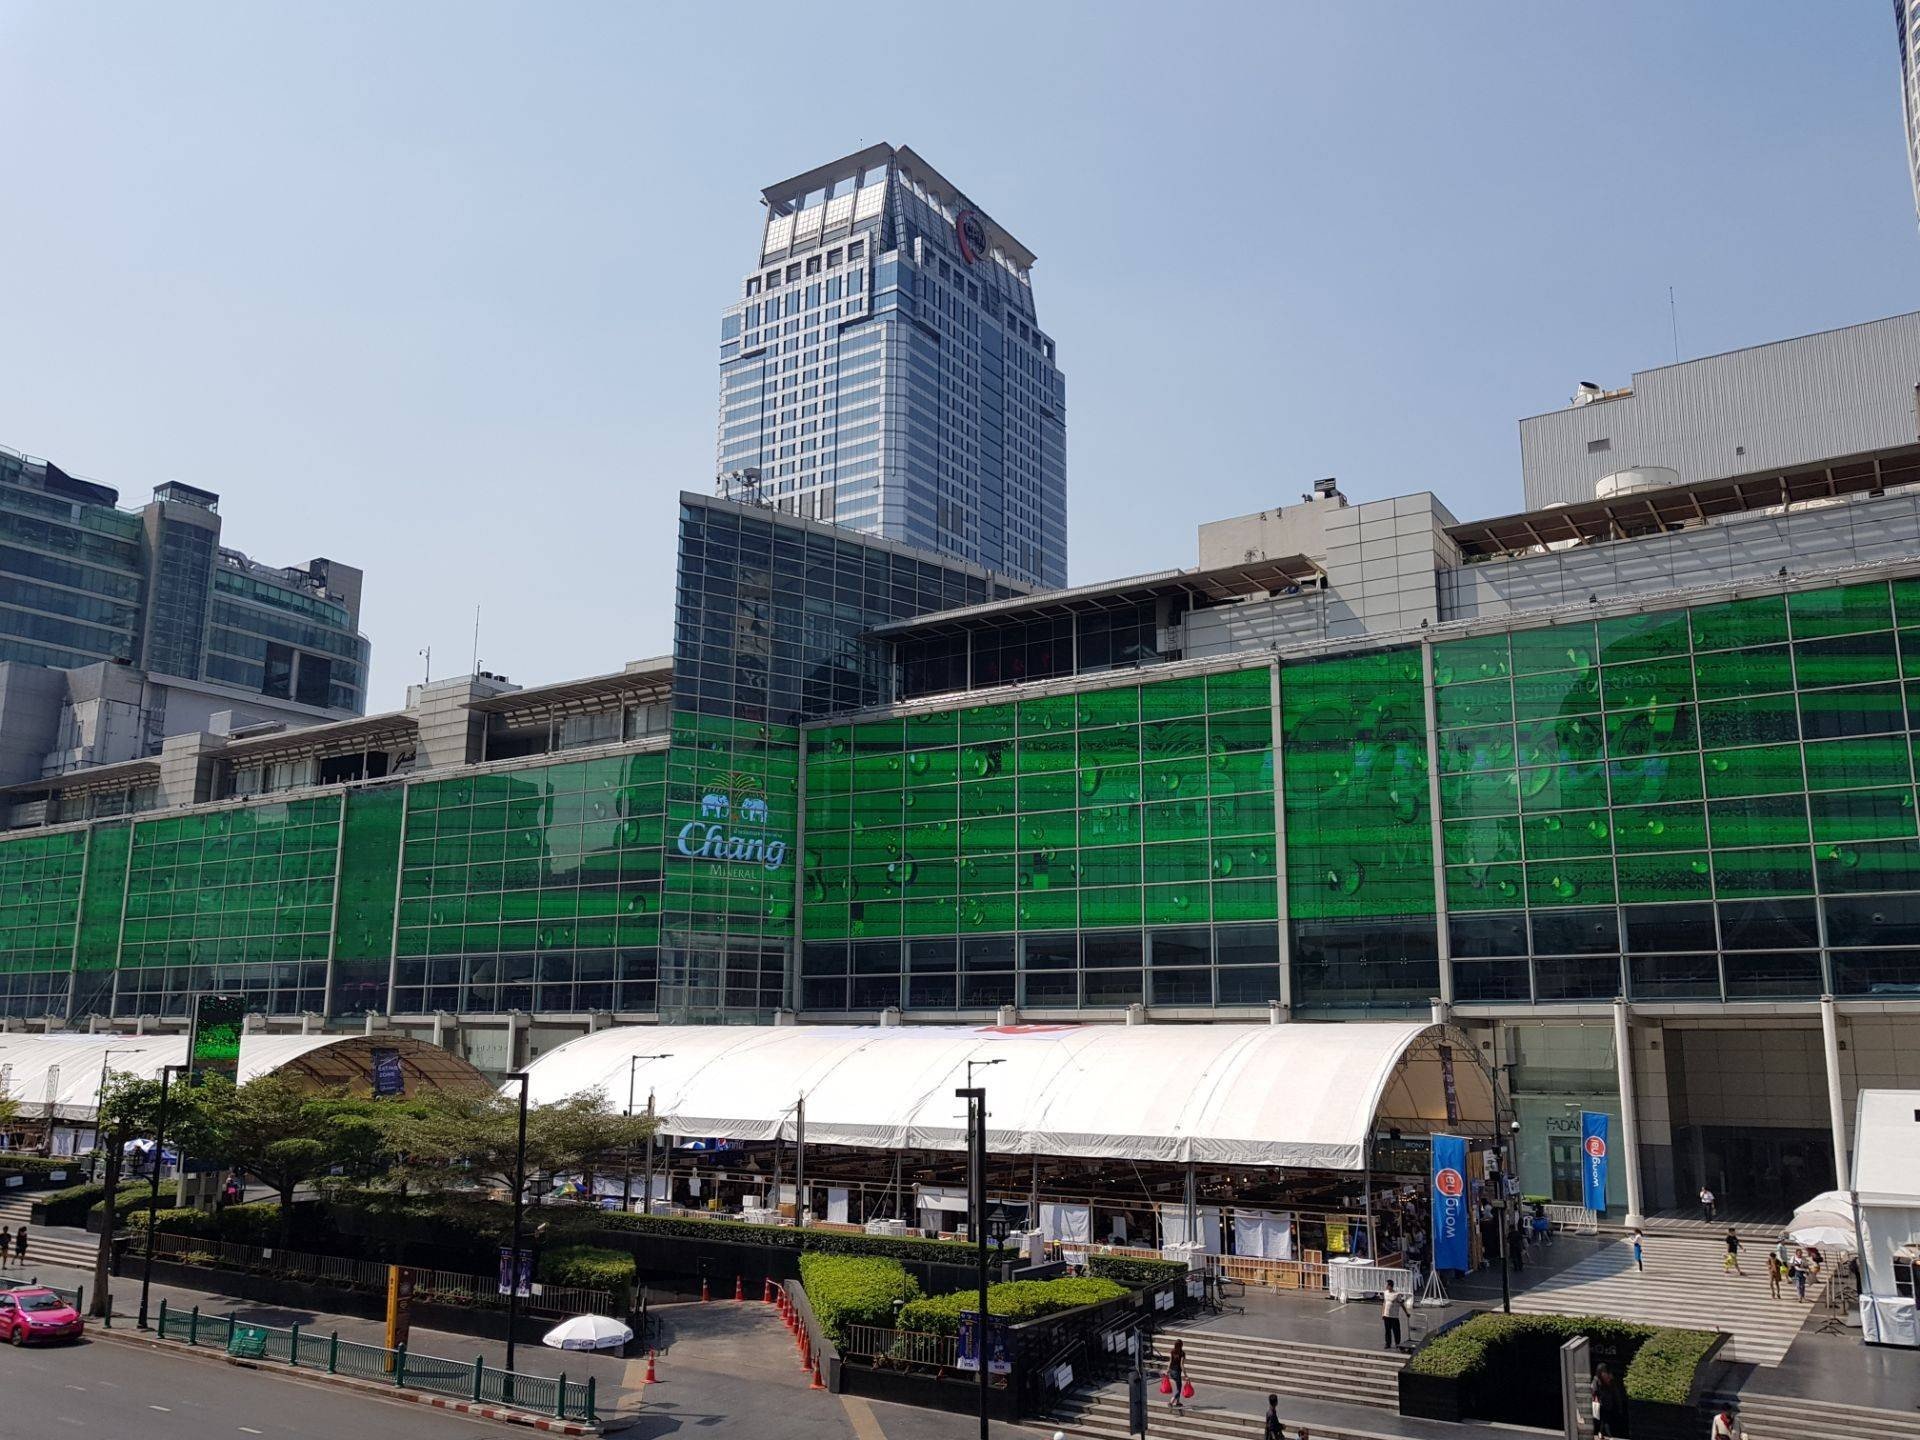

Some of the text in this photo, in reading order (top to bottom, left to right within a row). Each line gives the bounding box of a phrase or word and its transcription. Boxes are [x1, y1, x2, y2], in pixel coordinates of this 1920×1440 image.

[677, 822, 786, 871] Chang
[710, 864, 757, 879] MINERAL
[1444, 1173, 1460, 1239] wongnai
